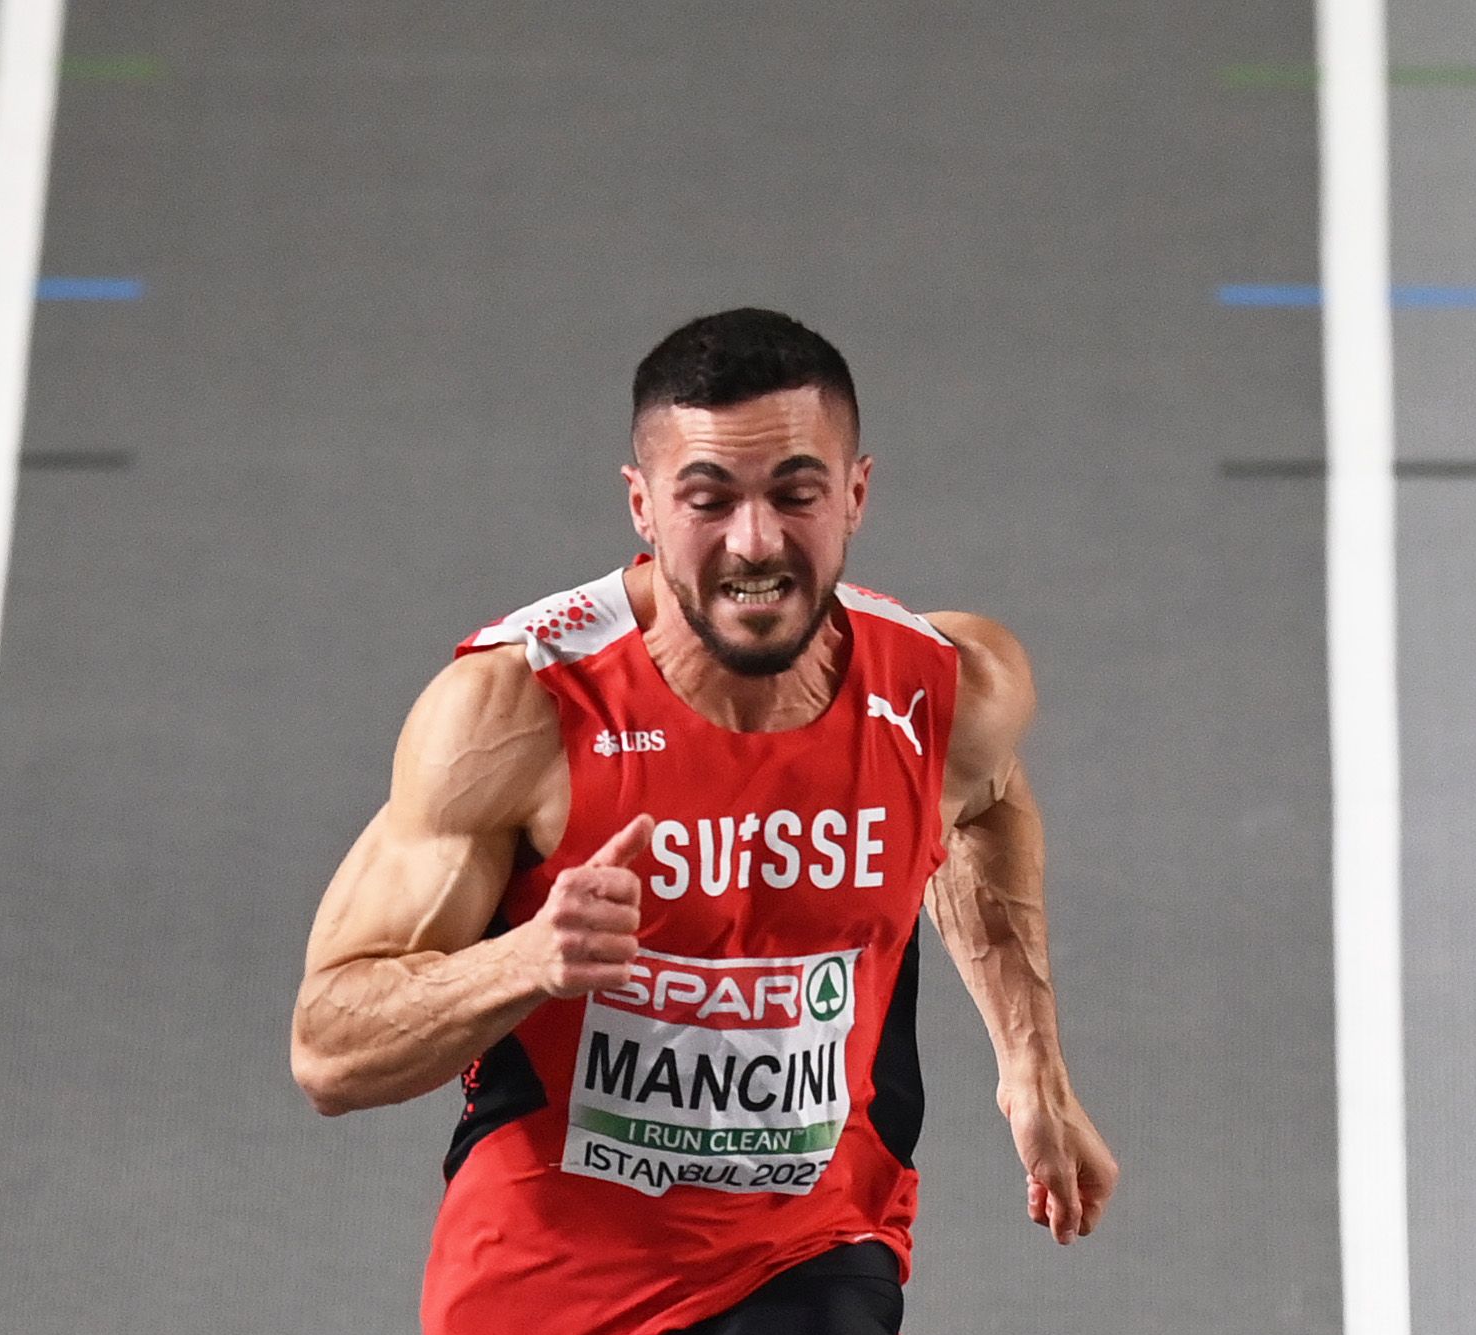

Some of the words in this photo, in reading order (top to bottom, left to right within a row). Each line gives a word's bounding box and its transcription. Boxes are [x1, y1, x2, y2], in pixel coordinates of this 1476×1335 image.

[620, 729, 666, 752] UBS
[602, 964, 799, 1021] SPAR
[584, 1030, 837, 1113] MANCINI
[628, 1121, 636, 1141] I
[643, 1124, 702, 1150] RUN
[584, 1141, 742, 1188] ISTANBUL
[749, 1160, 829, 1186] 202
